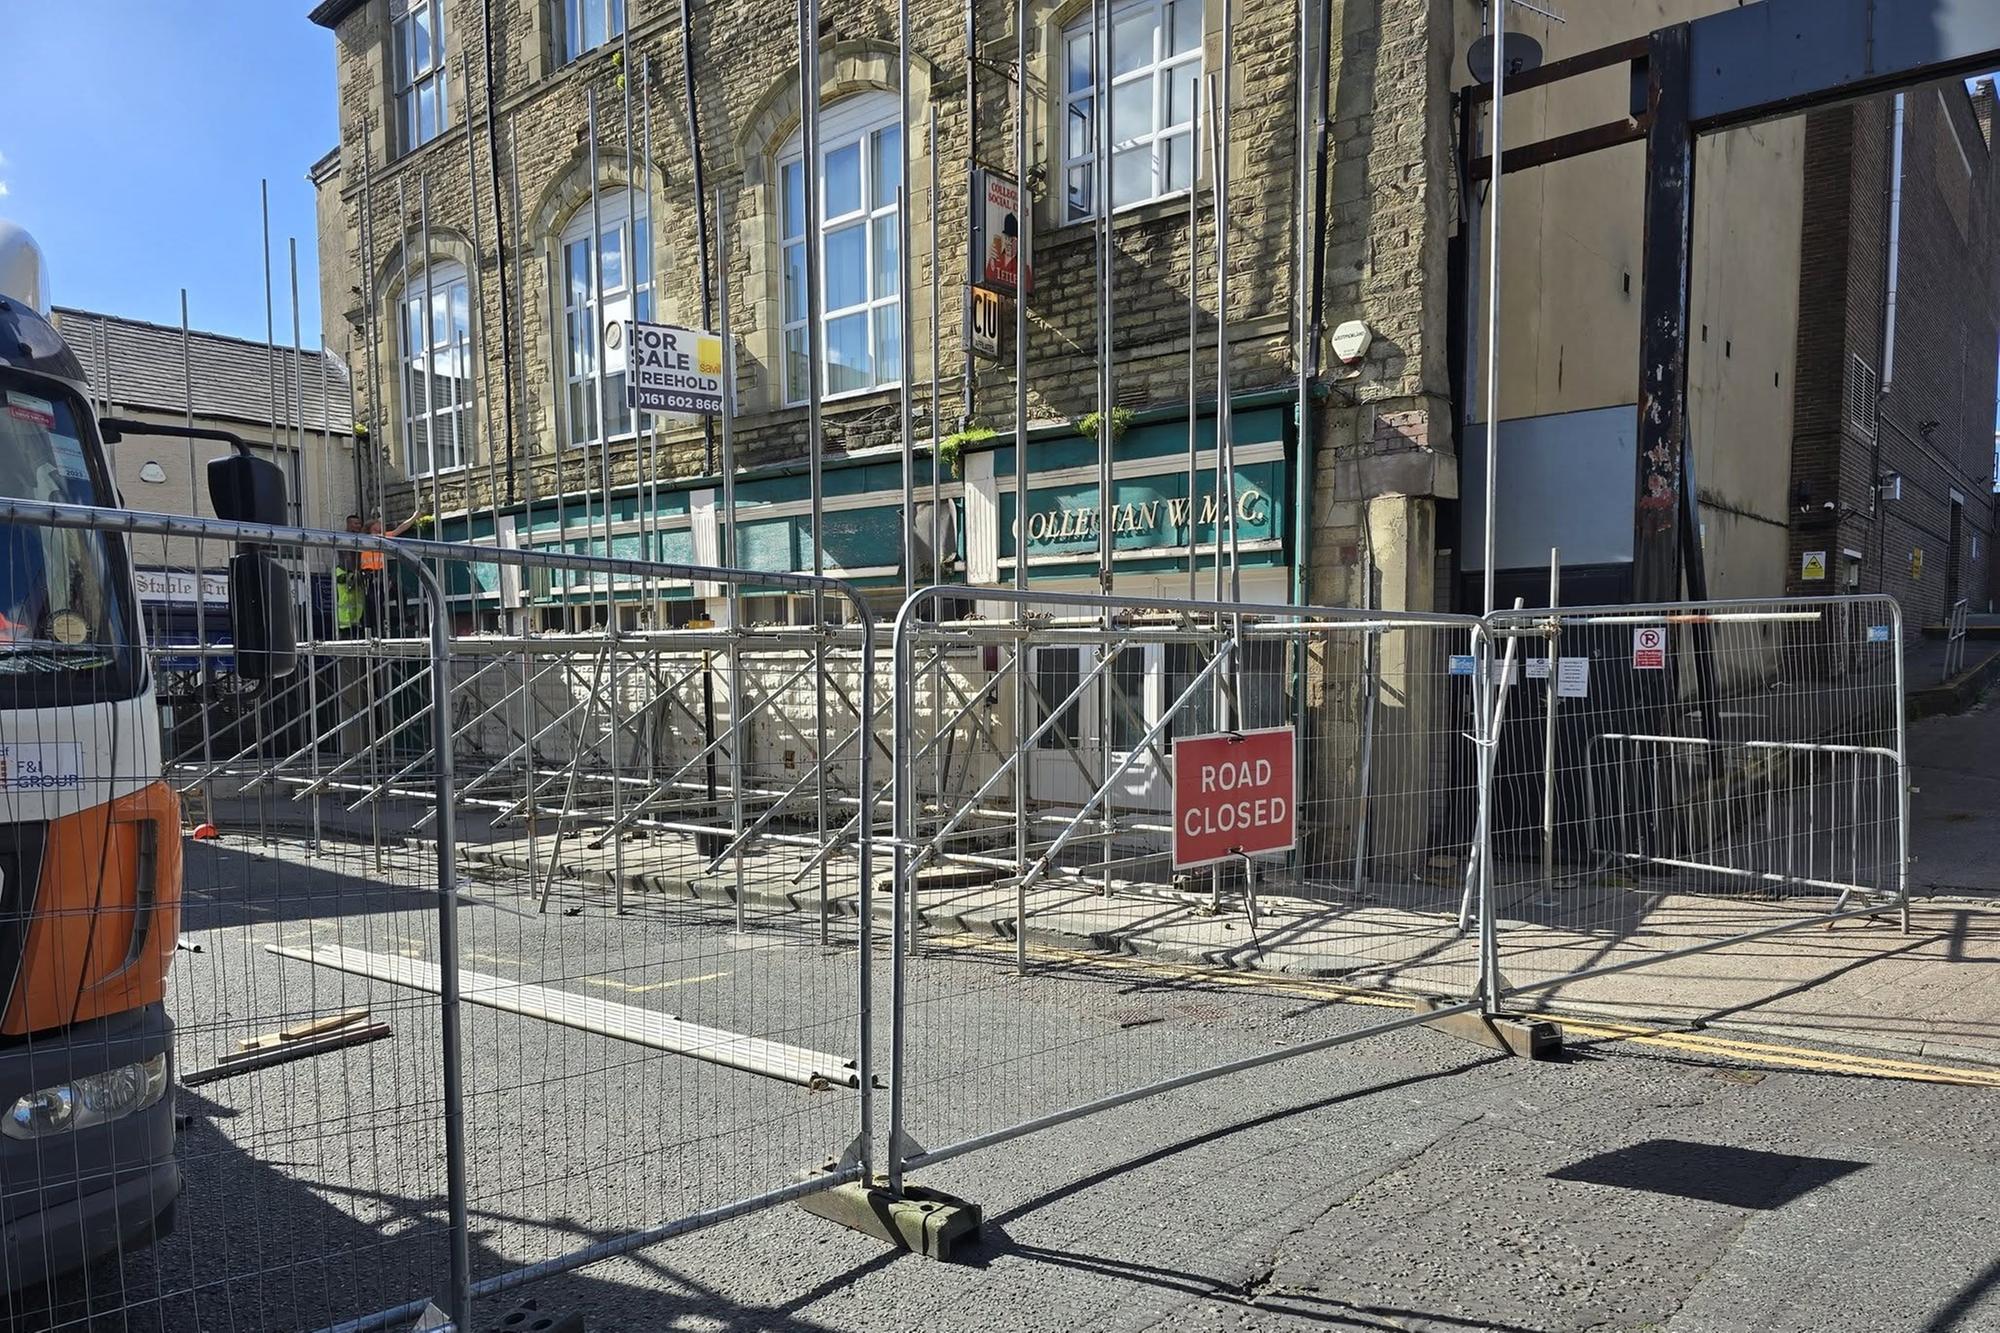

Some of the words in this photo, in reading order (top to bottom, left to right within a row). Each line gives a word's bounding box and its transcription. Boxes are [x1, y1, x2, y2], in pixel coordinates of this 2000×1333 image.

[991, 182, 1018, 200] COLLEG
[988, 193, 1011, 210] SOCIAL
[1013, 203, 1029, 217] CB
[996, 266, 1018, 285] TETLE
[973, 293, 997, 339] CIU
[629, 329, 677, 351] FOR
[630, 348, 690, 371] SALE
[667, 395, 693, 409] 602
[136, 574, 192, 594] Stable
[18, 774, 79, 788] GROUP
[1201, 759, 1272, 793] ROAD
[1184, 797, 1286, 837] CLOSED
